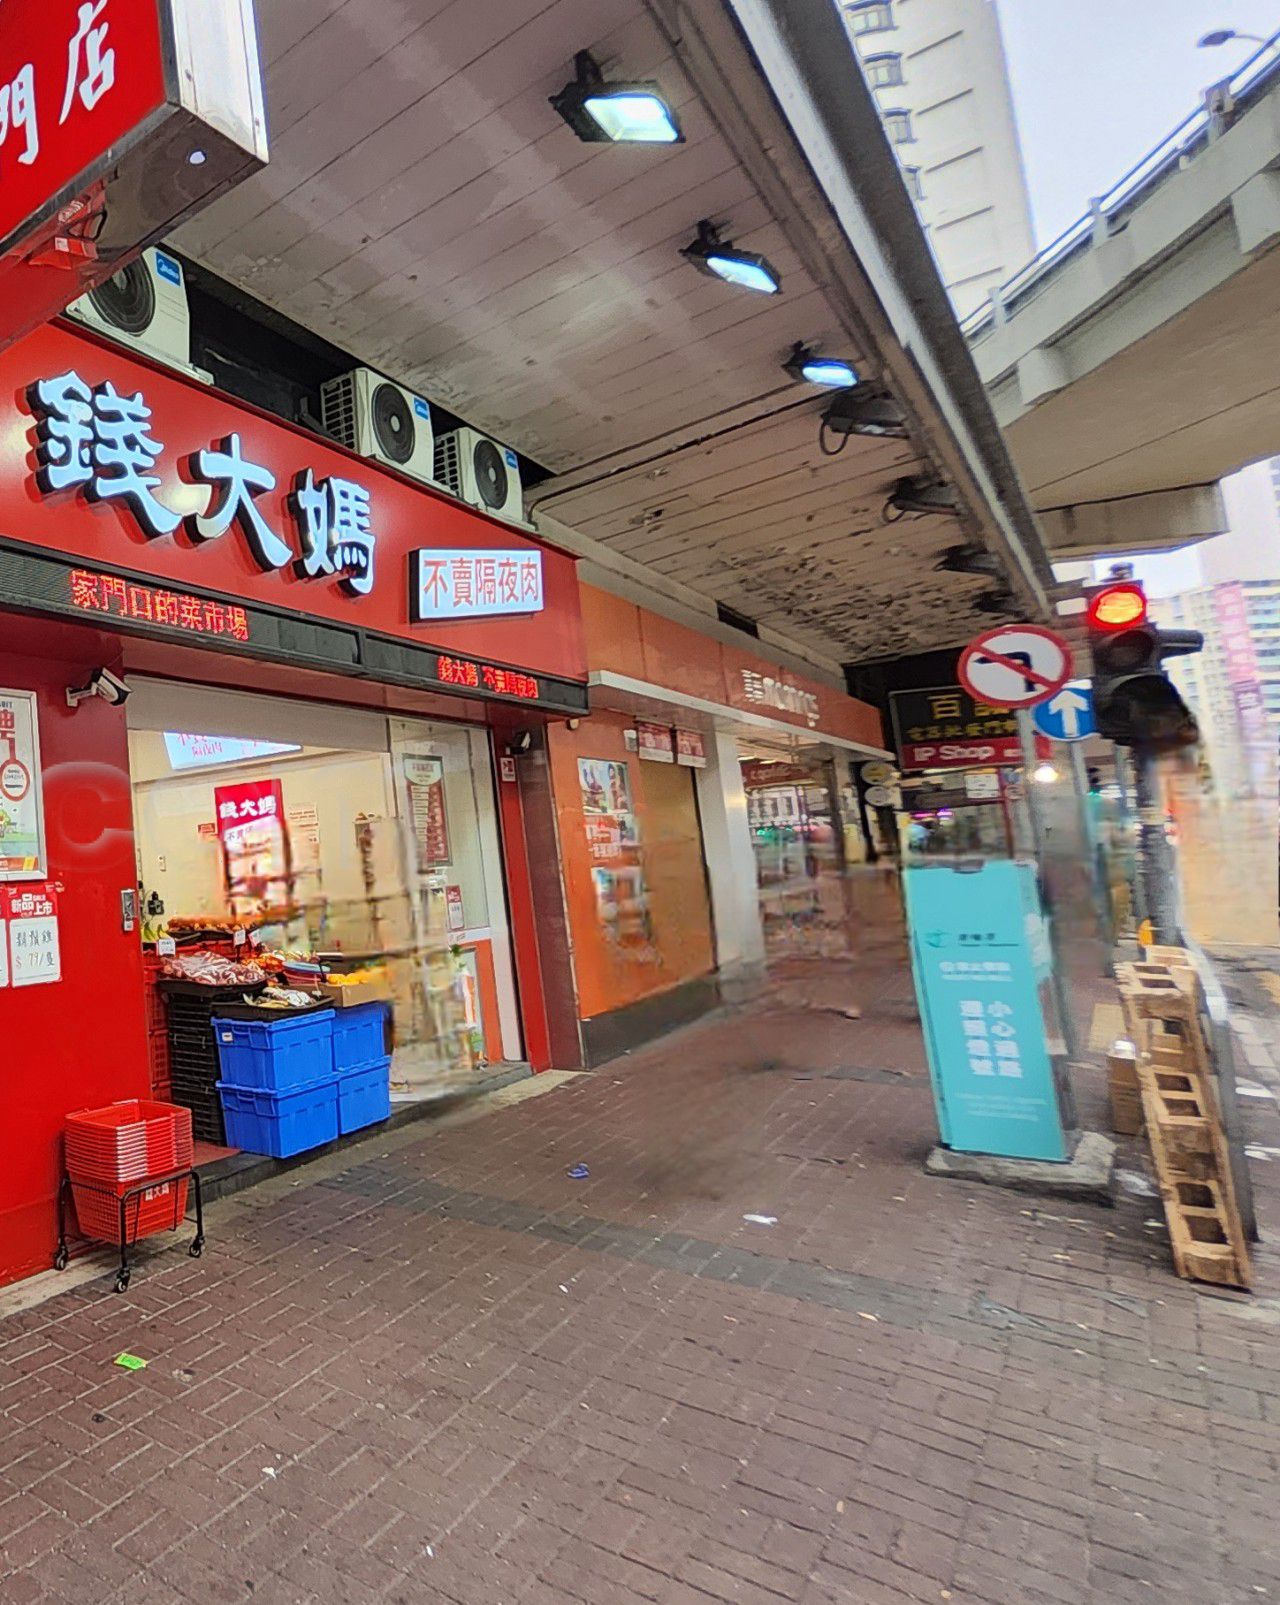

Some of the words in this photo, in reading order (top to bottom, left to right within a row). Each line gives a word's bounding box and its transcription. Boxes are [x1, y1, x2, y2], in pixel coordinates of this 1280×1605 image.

[26, 370, 377, 597] 錢大媽
[68, 567, 249, 642] 家門口的菜市場
[423, 553, 541, 609] 不賣隔夜肉
